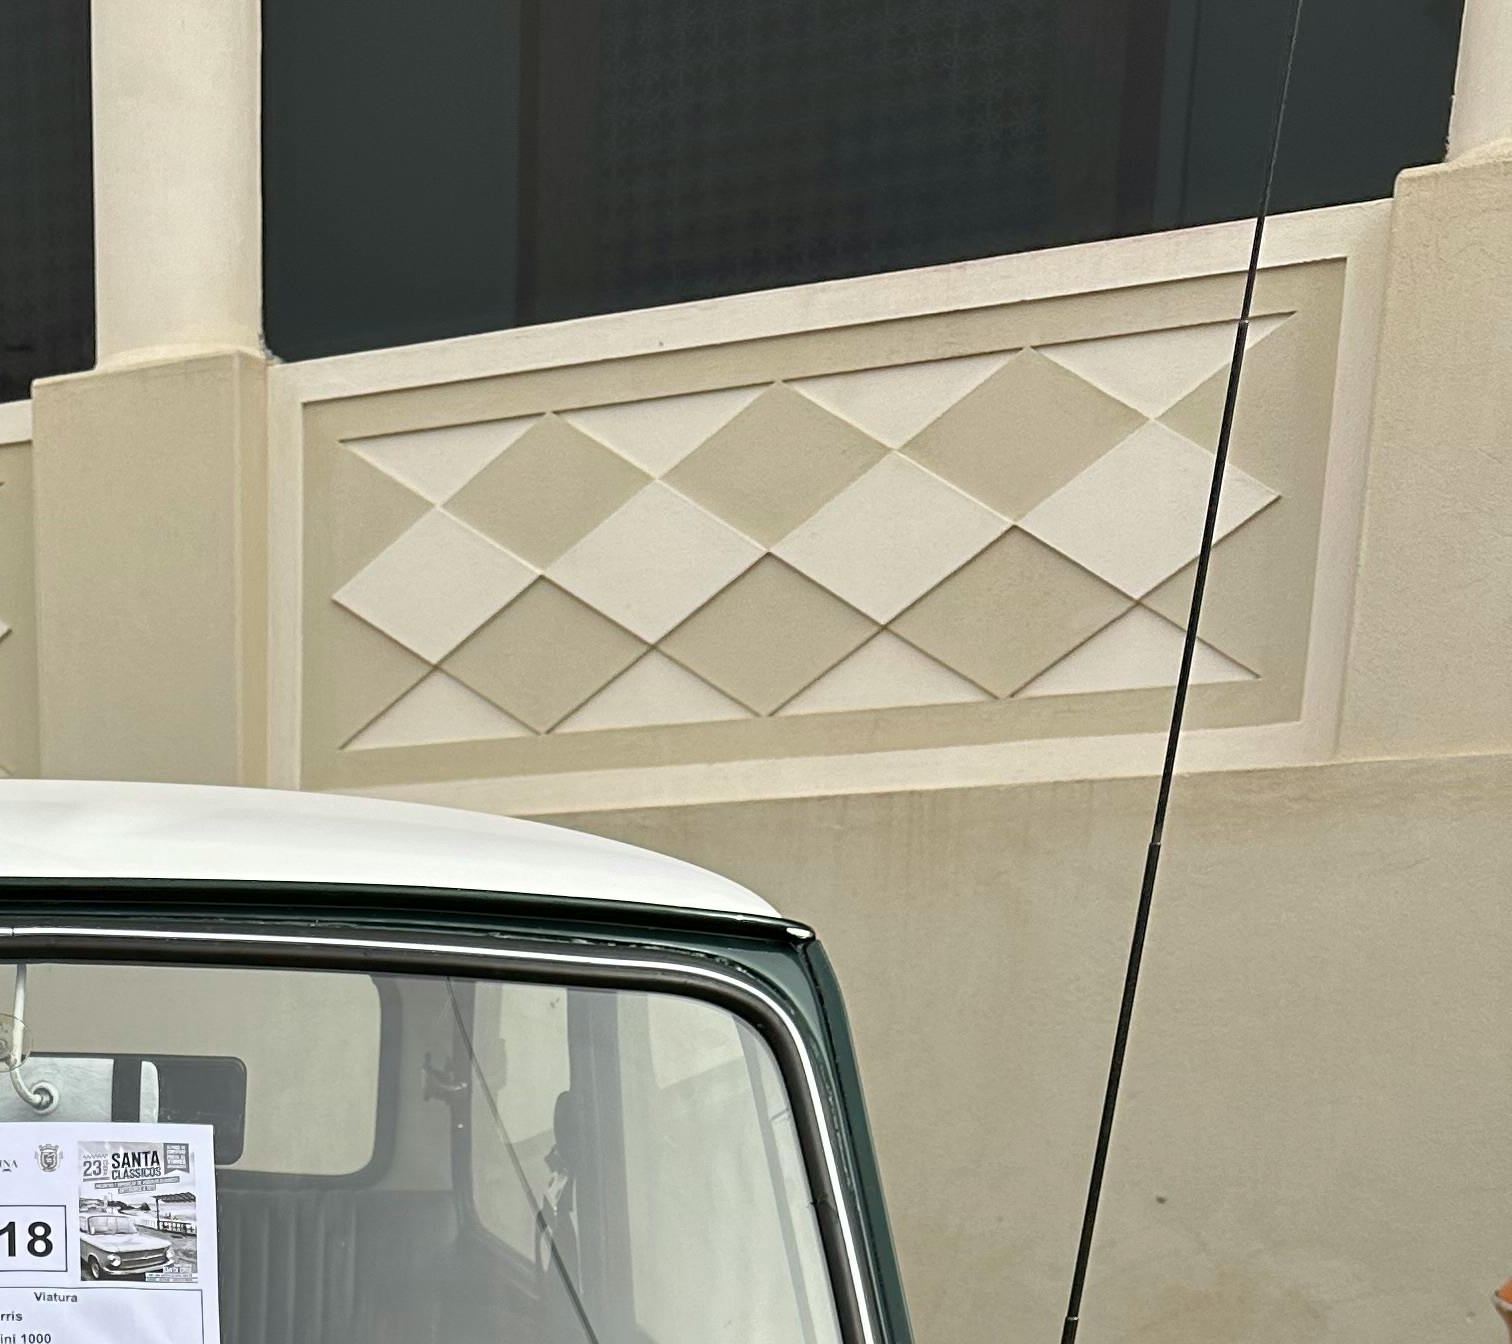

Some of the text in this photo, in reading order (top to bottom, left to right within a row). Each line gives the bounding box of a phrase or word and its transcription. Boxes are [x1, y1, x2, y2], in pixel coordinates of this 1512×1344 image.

[111, 1150, 160, 1169] SANTA
[83, 1160, 102, 1177] 23
[111, 1166, 162, 1181] CLÁSSICOS
[33, 1291, 78, 1303] Viatura
[20, 1332, 52, 1344] 1000
